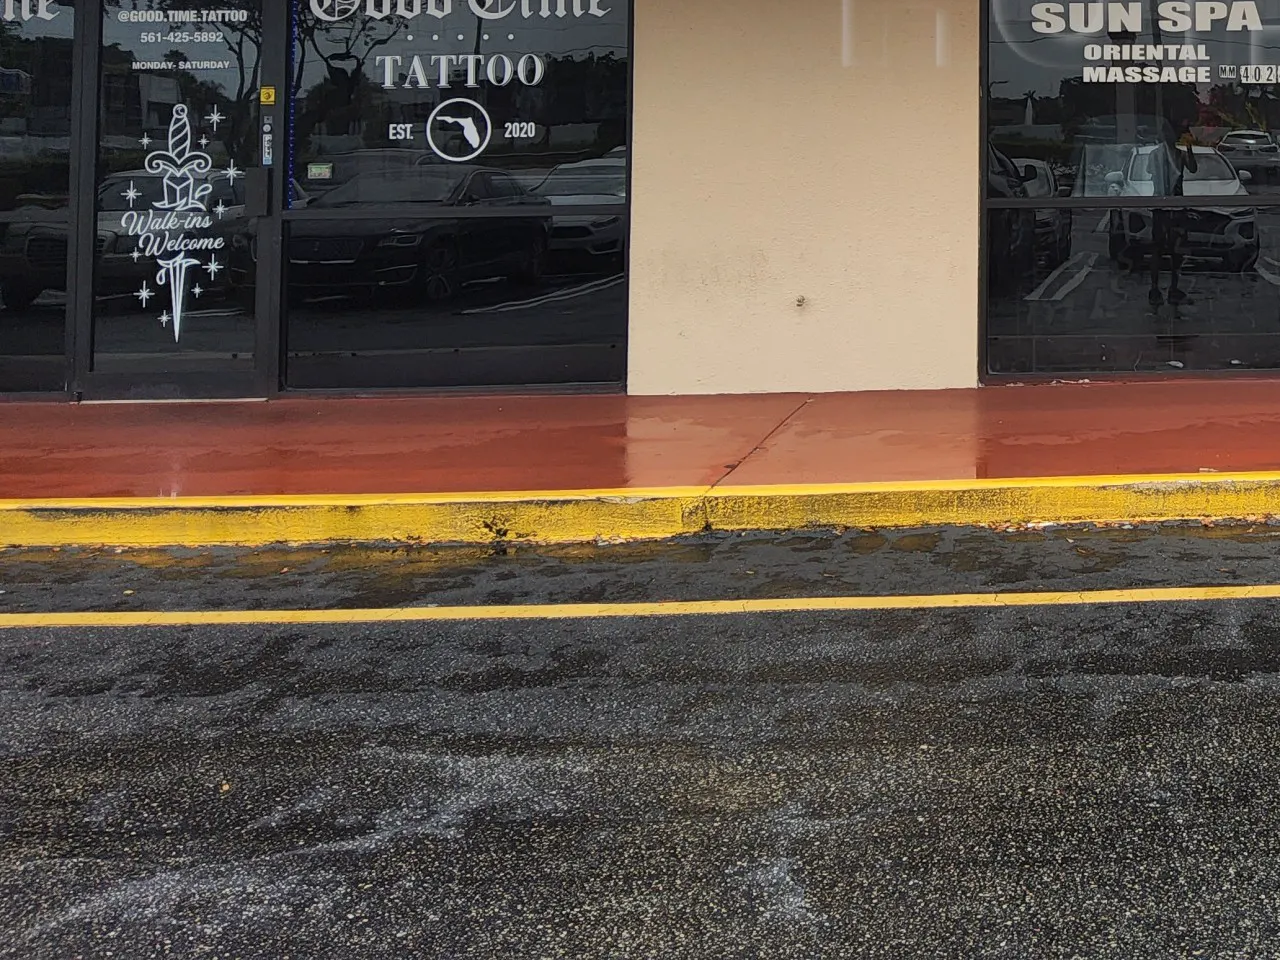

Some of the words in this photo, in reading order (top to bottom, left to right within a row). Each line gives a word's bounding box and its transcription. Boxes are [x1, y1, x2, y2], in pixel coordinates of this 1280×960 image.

[117, 9, 248, 23] @GOOD.TIME.TATTOO
[1030, 2, 1142, 33] SUN
[1157, 0, 1264, 32] SPA
[140, 32, 224, 43] 561-425-5892
[1083, 43, 1210, 61] ORIENTAL
[178, 61, 230, 69] SATURDAY
[375, 53, 545, 90] TATTOO
[1219, 65, 1236, 78] MM
[1082, 66, 1211, 83] MASSAGE
[388, 123, 414, 140] EST.
[504, 122, 536, 138] 2020
[120, 208, 213, 236] Walk-ins
[138, 230, 225, 257] Welcome
